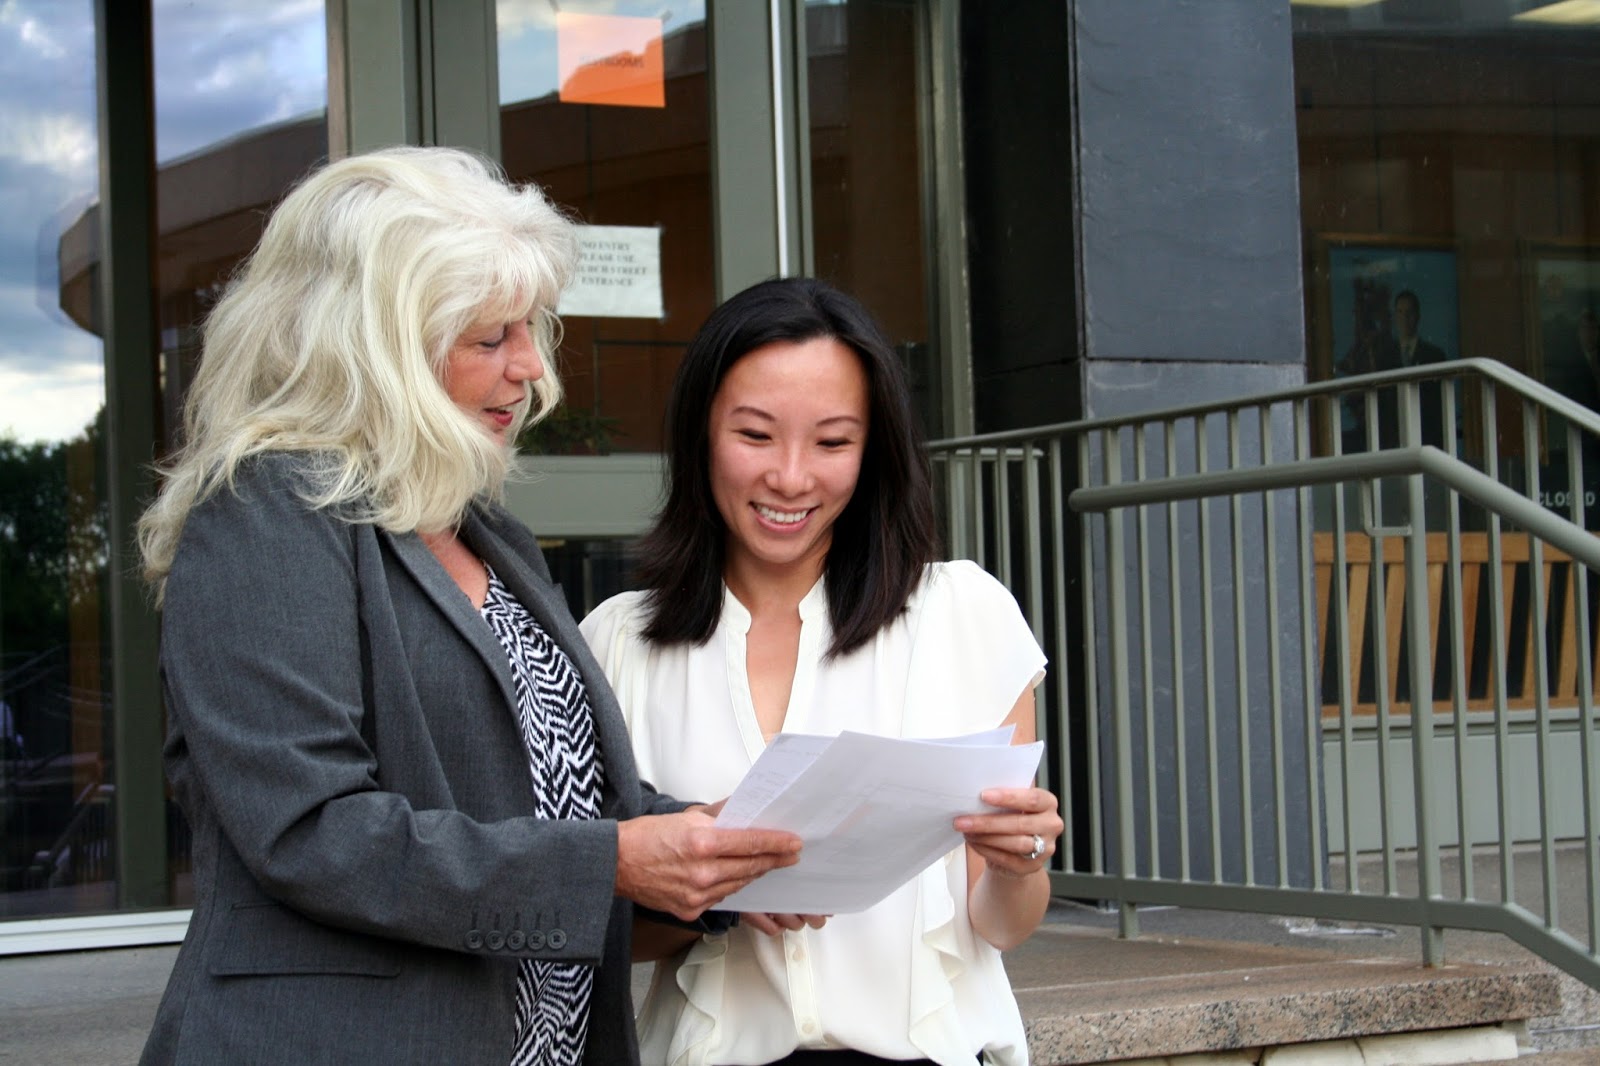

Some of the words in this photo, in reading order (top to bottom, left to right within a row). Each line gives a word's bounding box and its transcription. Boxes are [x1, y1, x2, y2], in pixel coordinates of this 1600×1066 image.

[582, 241, 597, 250] NO
[598, 241, 631, 251] ENTRY
[578, 252, 613, 262] PLEASE
[575, 265, 609, 274] URCH
[610, 266, 647, 276] STREET
[582, 276, 633, 287] ENTRANCE
[1539, 491, 1596, 507] LOD
